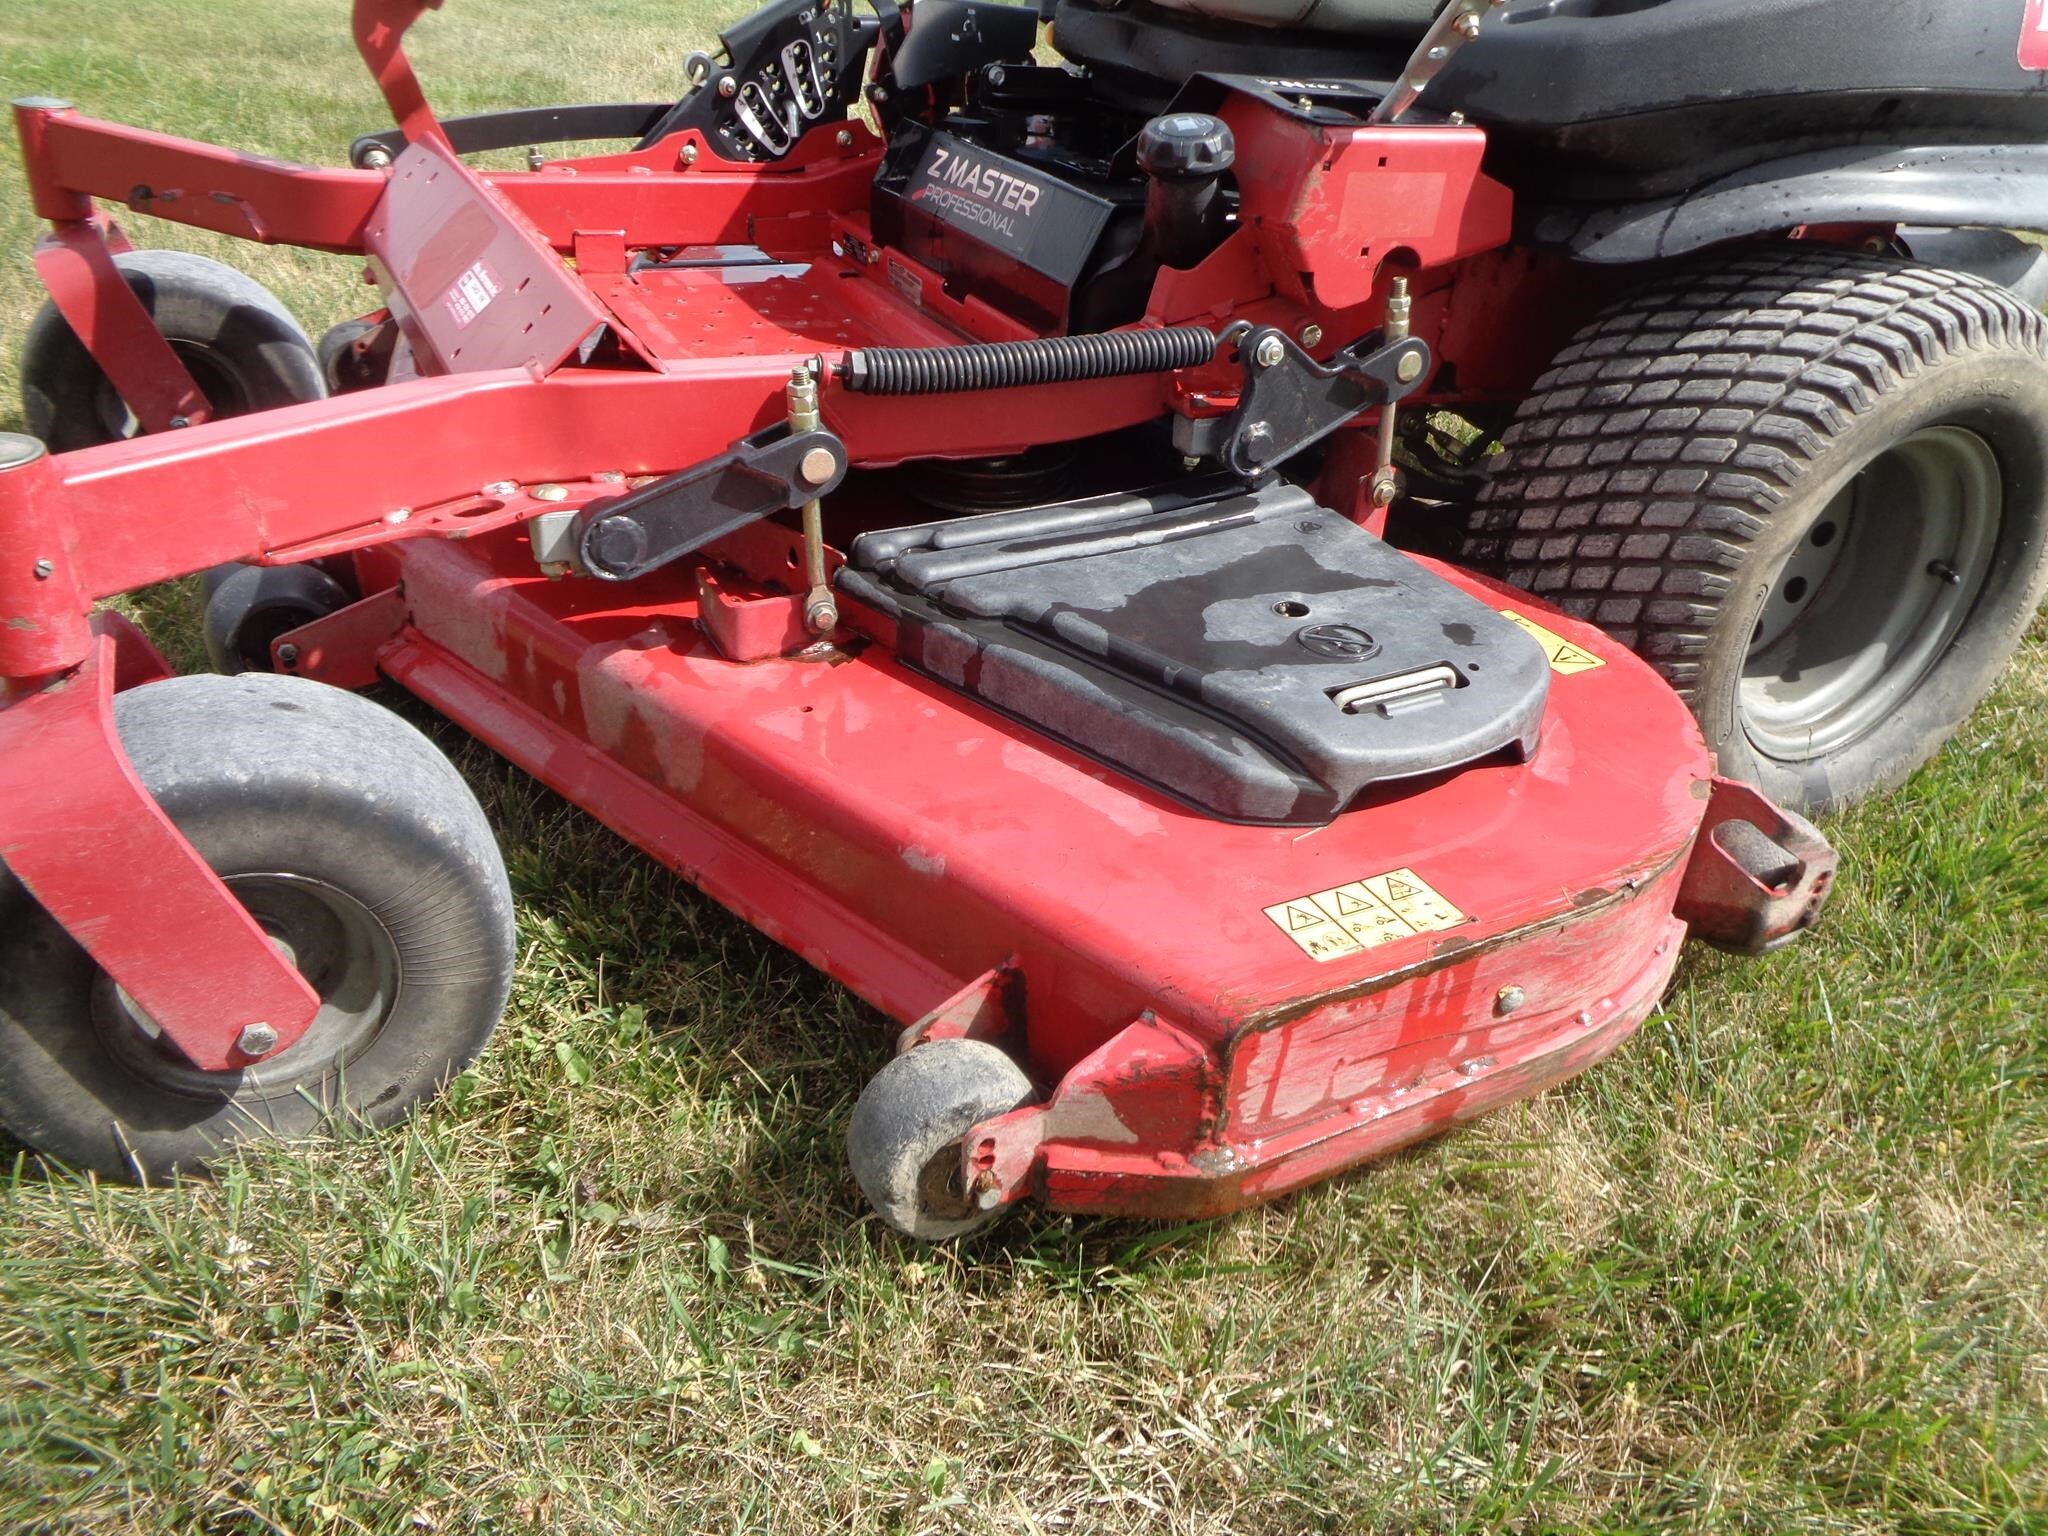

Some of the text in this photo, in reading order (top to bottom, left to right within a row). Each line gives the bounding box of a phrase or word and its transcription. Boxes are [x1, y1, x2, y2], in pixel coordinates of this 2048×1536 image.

[923, 183, 1014, 238] PROFESSIONAL
[927, 148, 1040, 216] Z MASTER
